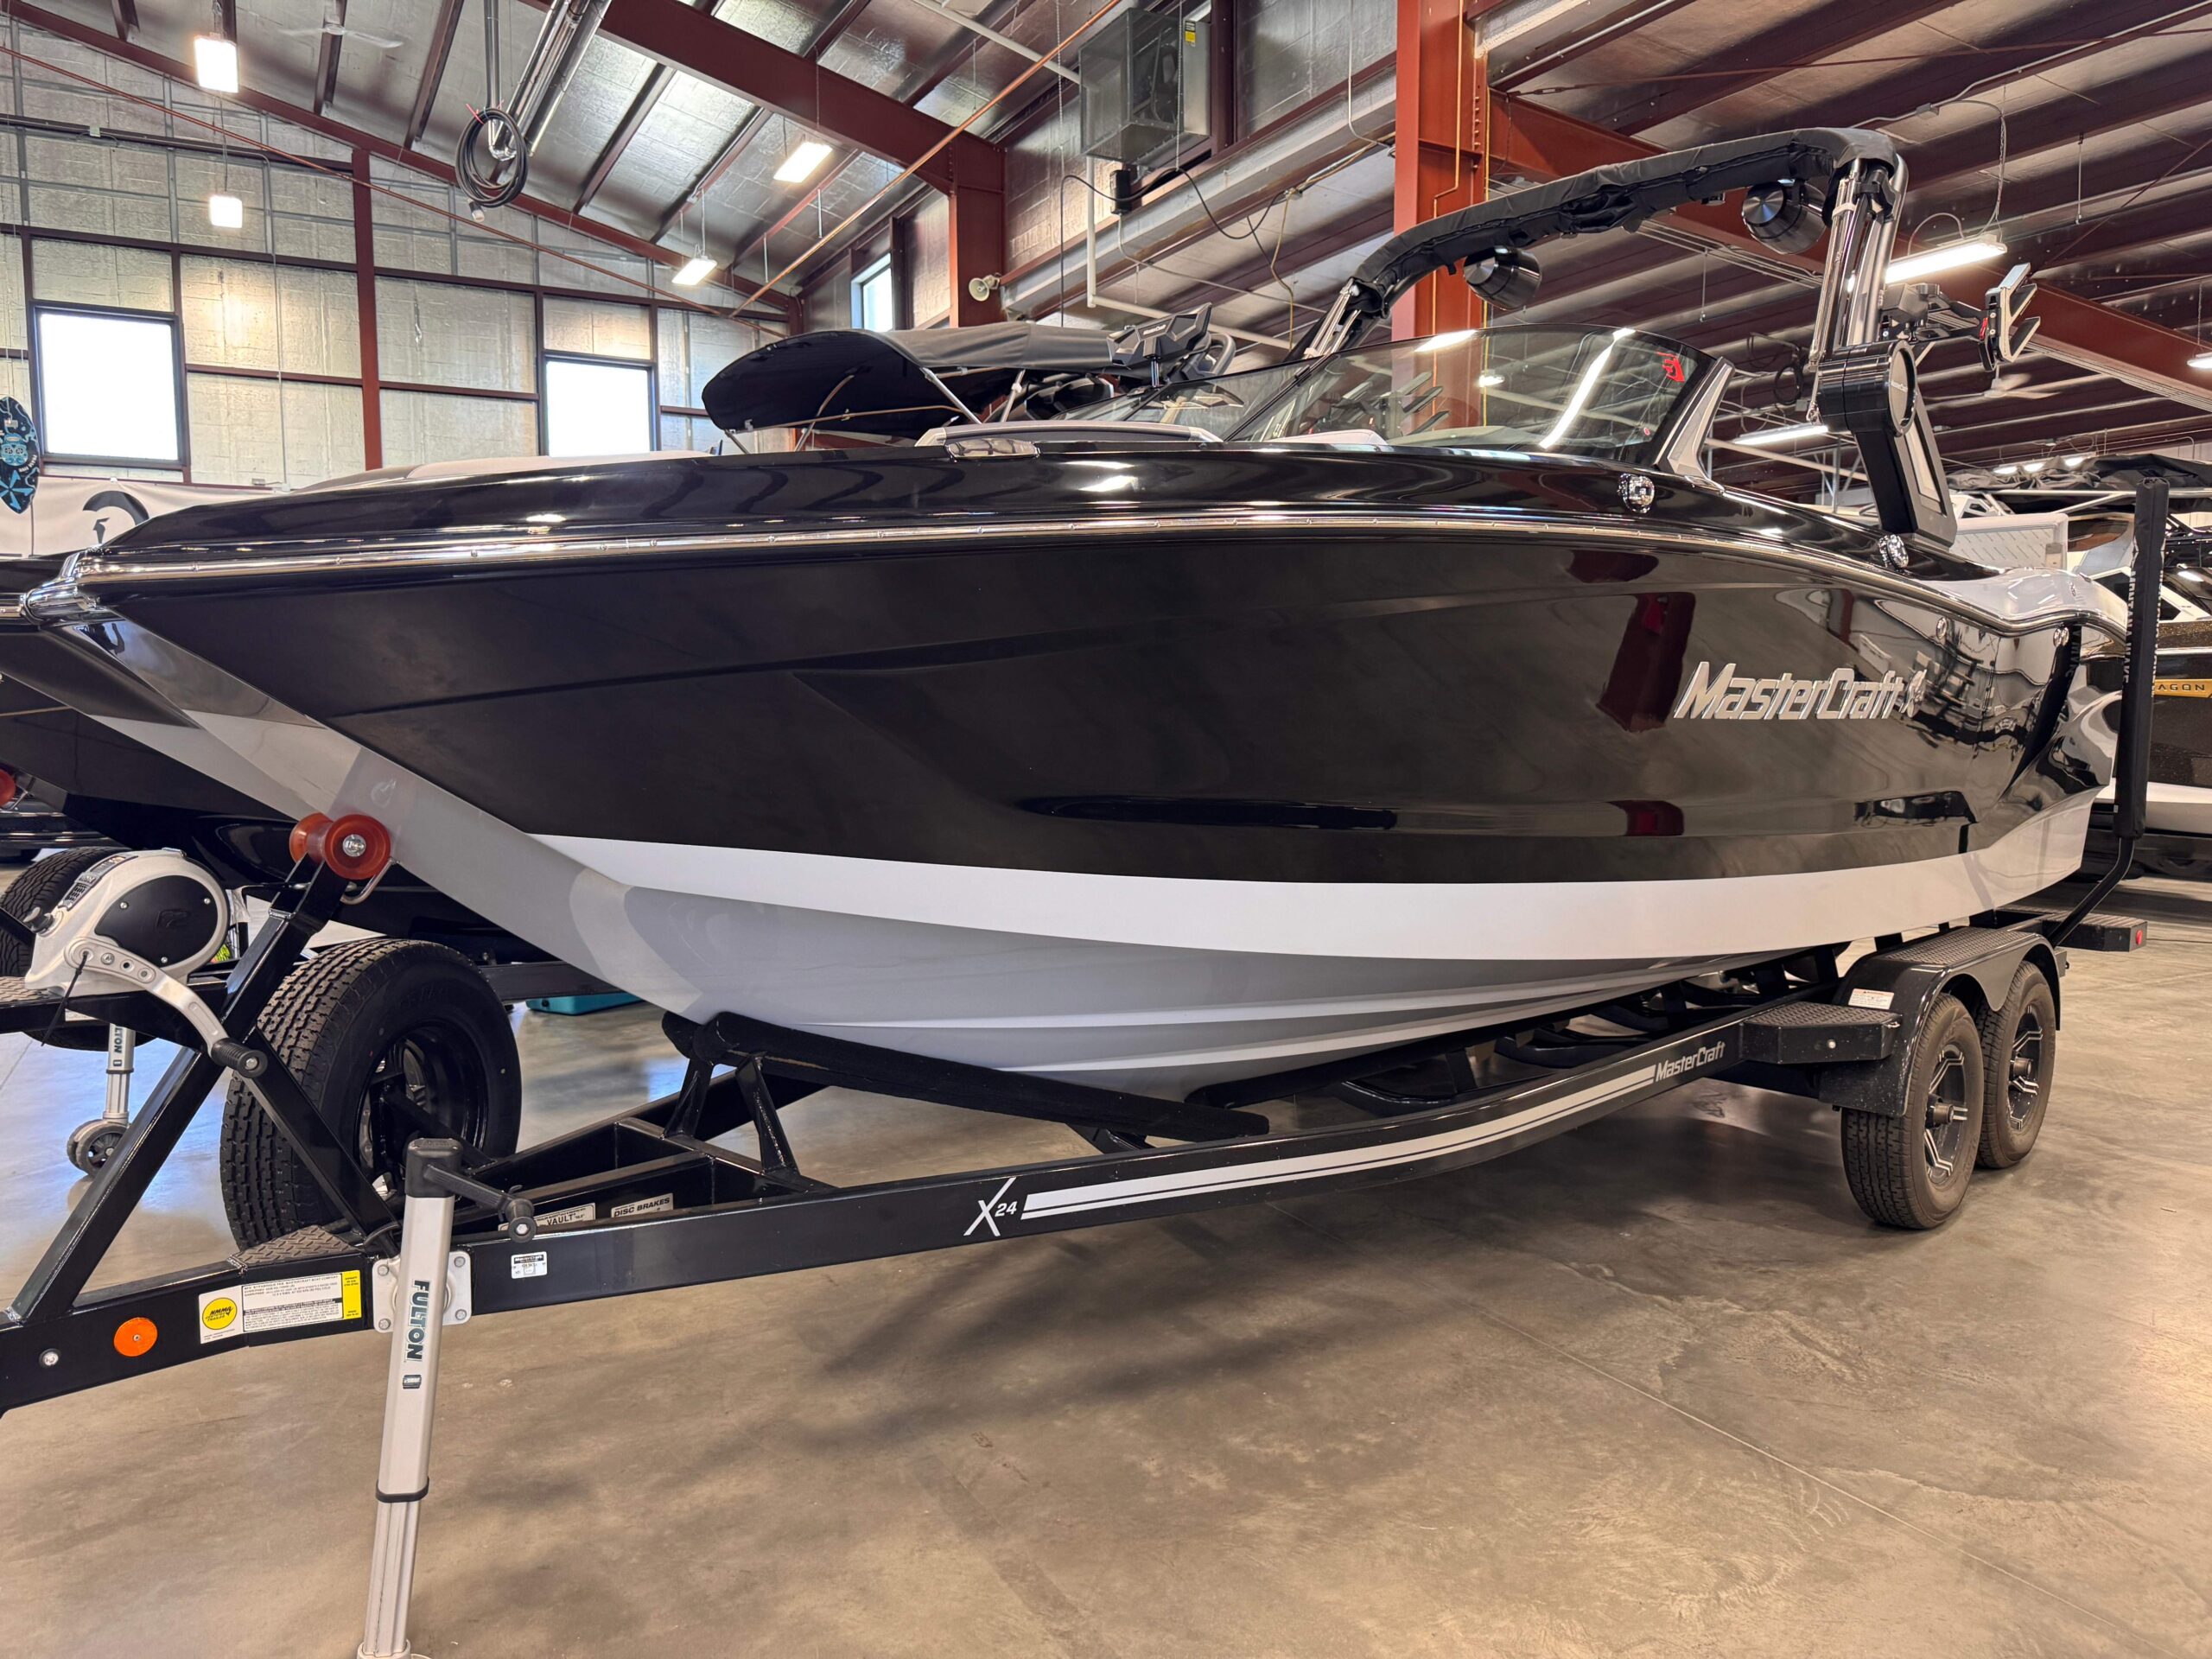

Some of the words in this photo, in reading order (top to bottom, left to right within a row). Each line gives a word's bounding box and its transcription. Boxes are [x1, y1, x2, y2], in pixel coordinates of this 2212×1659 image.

[1674, 661, 1904, 720] MasterCraft
[114, 1027, 124, 1053] LTON
[1656, 1040, 1726, 1082] MasterCraft
[614, 1206, 635, 1217] DISC
[637, 1197, 671, 1211] BRAKES
[406, 1280, 430, 1361] FULTON
